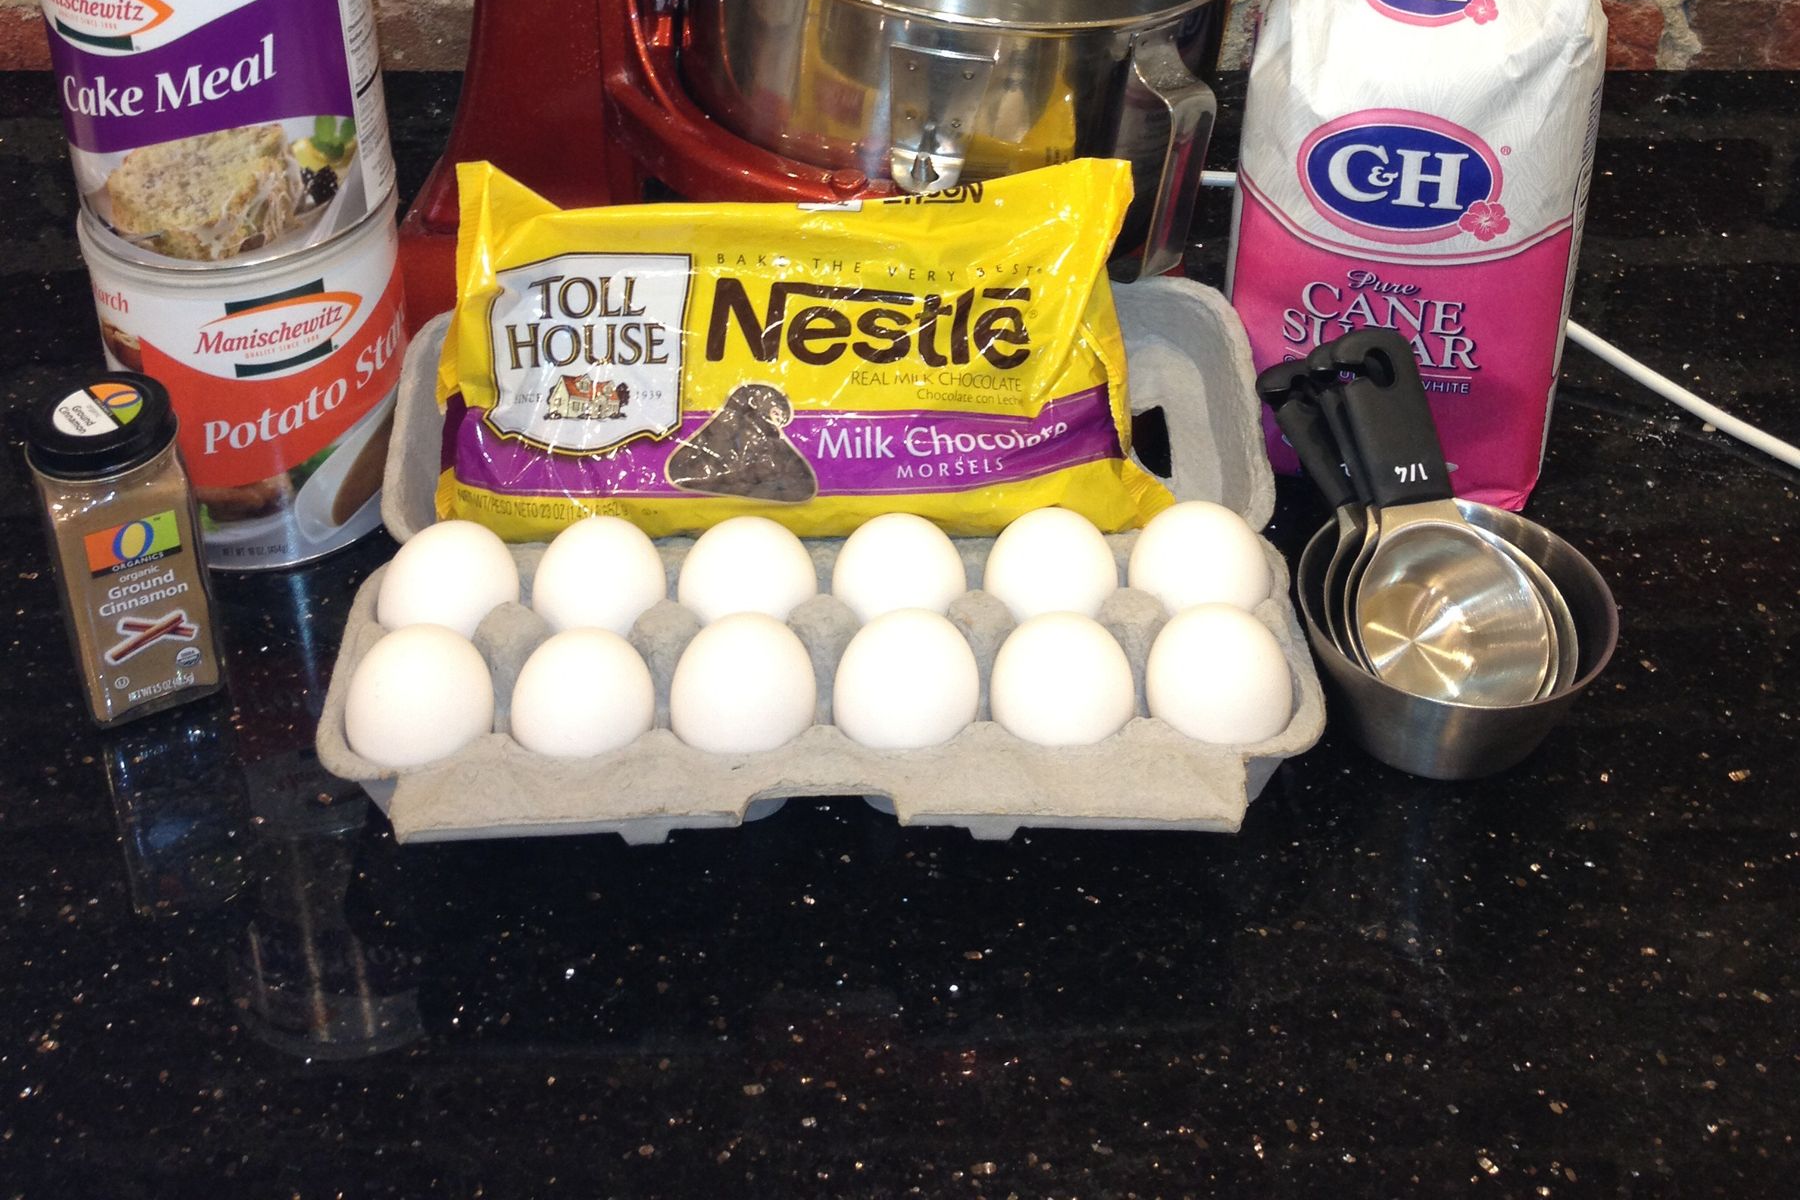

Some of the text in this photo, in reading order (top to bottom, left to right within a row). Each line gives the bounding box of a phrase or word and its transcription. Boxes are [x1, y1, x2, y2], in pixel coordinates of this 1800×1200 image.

[63, 33, 278, 119] Cake Meal
[1327, 143, 1470, 212] C&H
[812, 257, 861, 273] THE
[887, 264, 955, 282] VERY
[1347, 269, 1418, 296] Pure
[527, 275, 647, 320] TOLL
[1301, 281, 1464, 335] CANE
[193, 305, 344, 355] Manischewitz
[505, 322, 670, 371] HOUSE
[851, 370, 1023, 392] REAL MILK CHOCOLATE
[634, 389, 663, 401] 1939
[916, 388, 972, 404] Chocolate
[976, 393, 995, 404] con
[203, 377, 348, 455] Potato
[817, 426, 896, 460] Milk
[896, 456, 1004, 480] MORSELS
[1394, 462, 1429, 483] 1/4
[514, 503, 538, 518] NETO
[554, 504, 565, 520] OZ
[112, 551, 165, 572] ORGANICS
[119, 564, 160, 583] organic
[107, 568, 175, 600] Ground
[98, 582, 189, 617] Cinnamon
[162, 680, 173, 690] OZ
